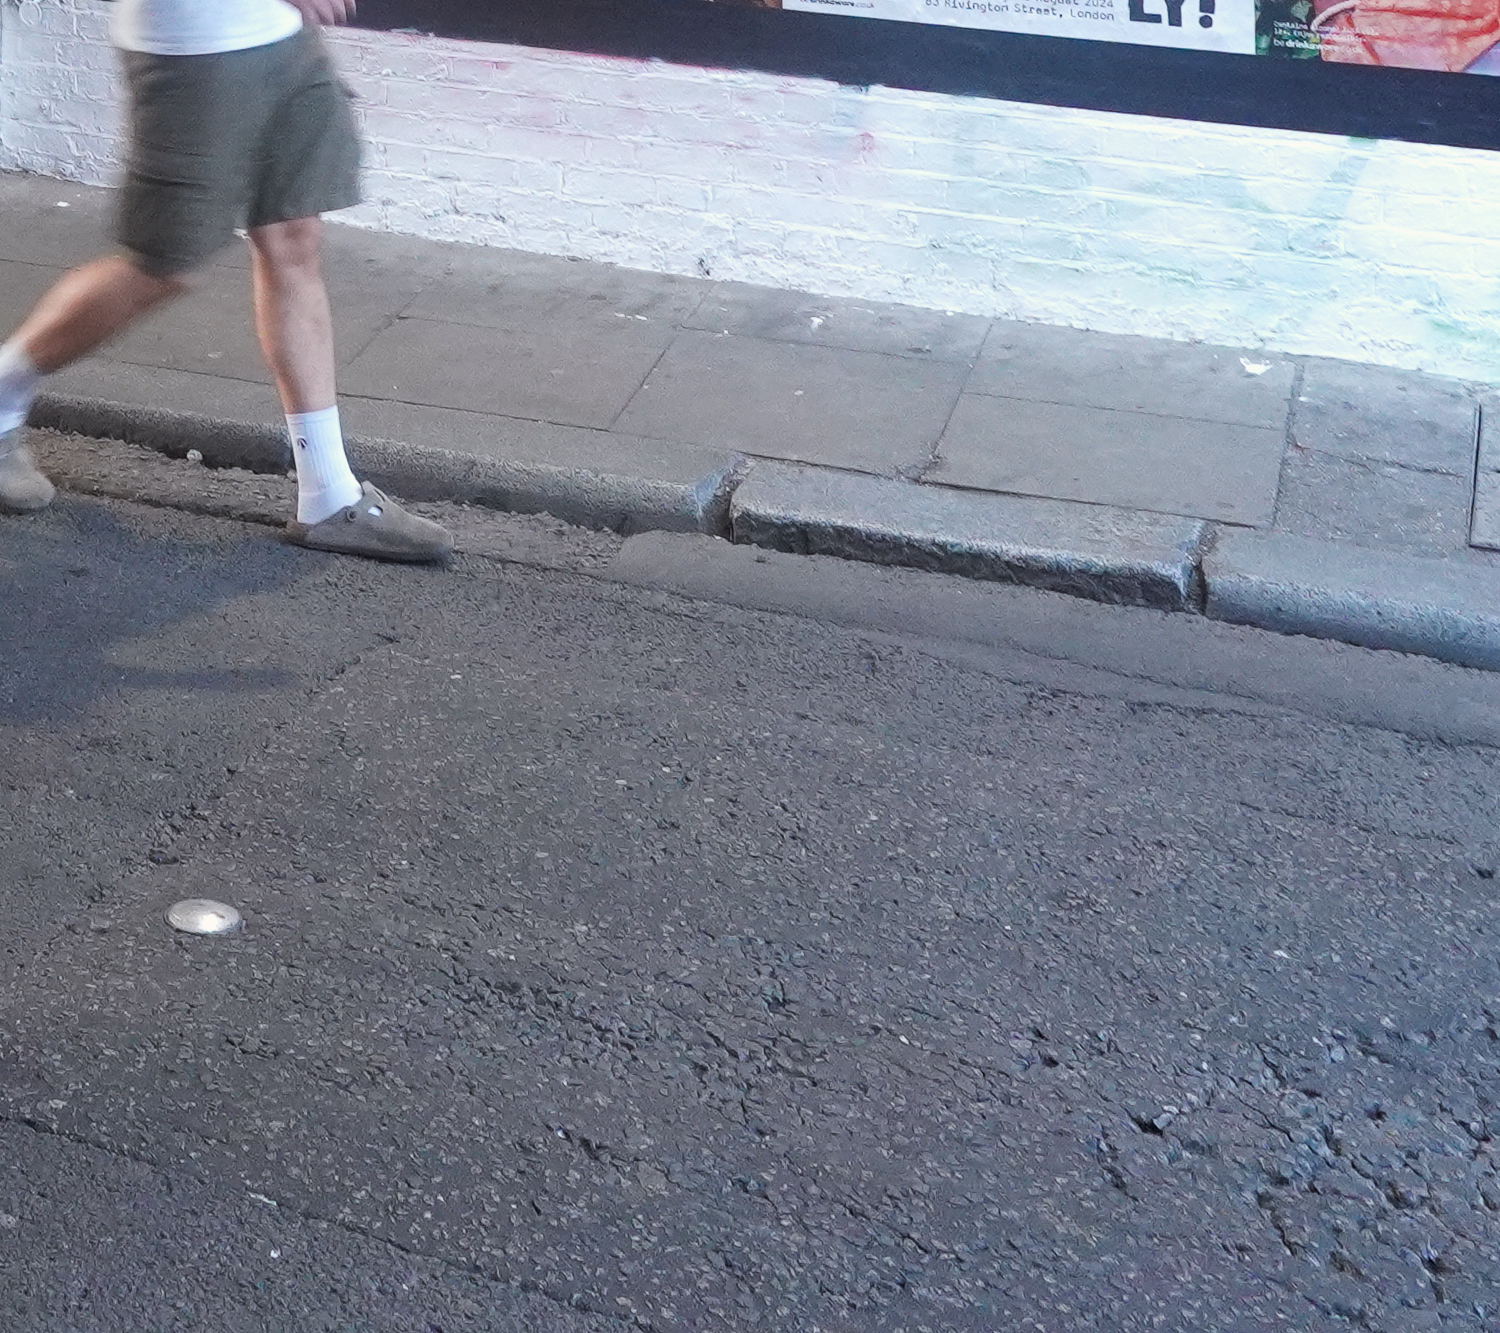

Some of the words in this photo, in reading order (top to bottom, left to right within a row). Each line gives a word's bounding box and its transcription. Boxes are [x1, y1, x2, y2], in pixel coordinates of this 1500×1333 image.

[945, 0, 1010, 15] Rivington
[1014, 4, 1064, 19] Street,
[1070, 9, 1115, 21] London
